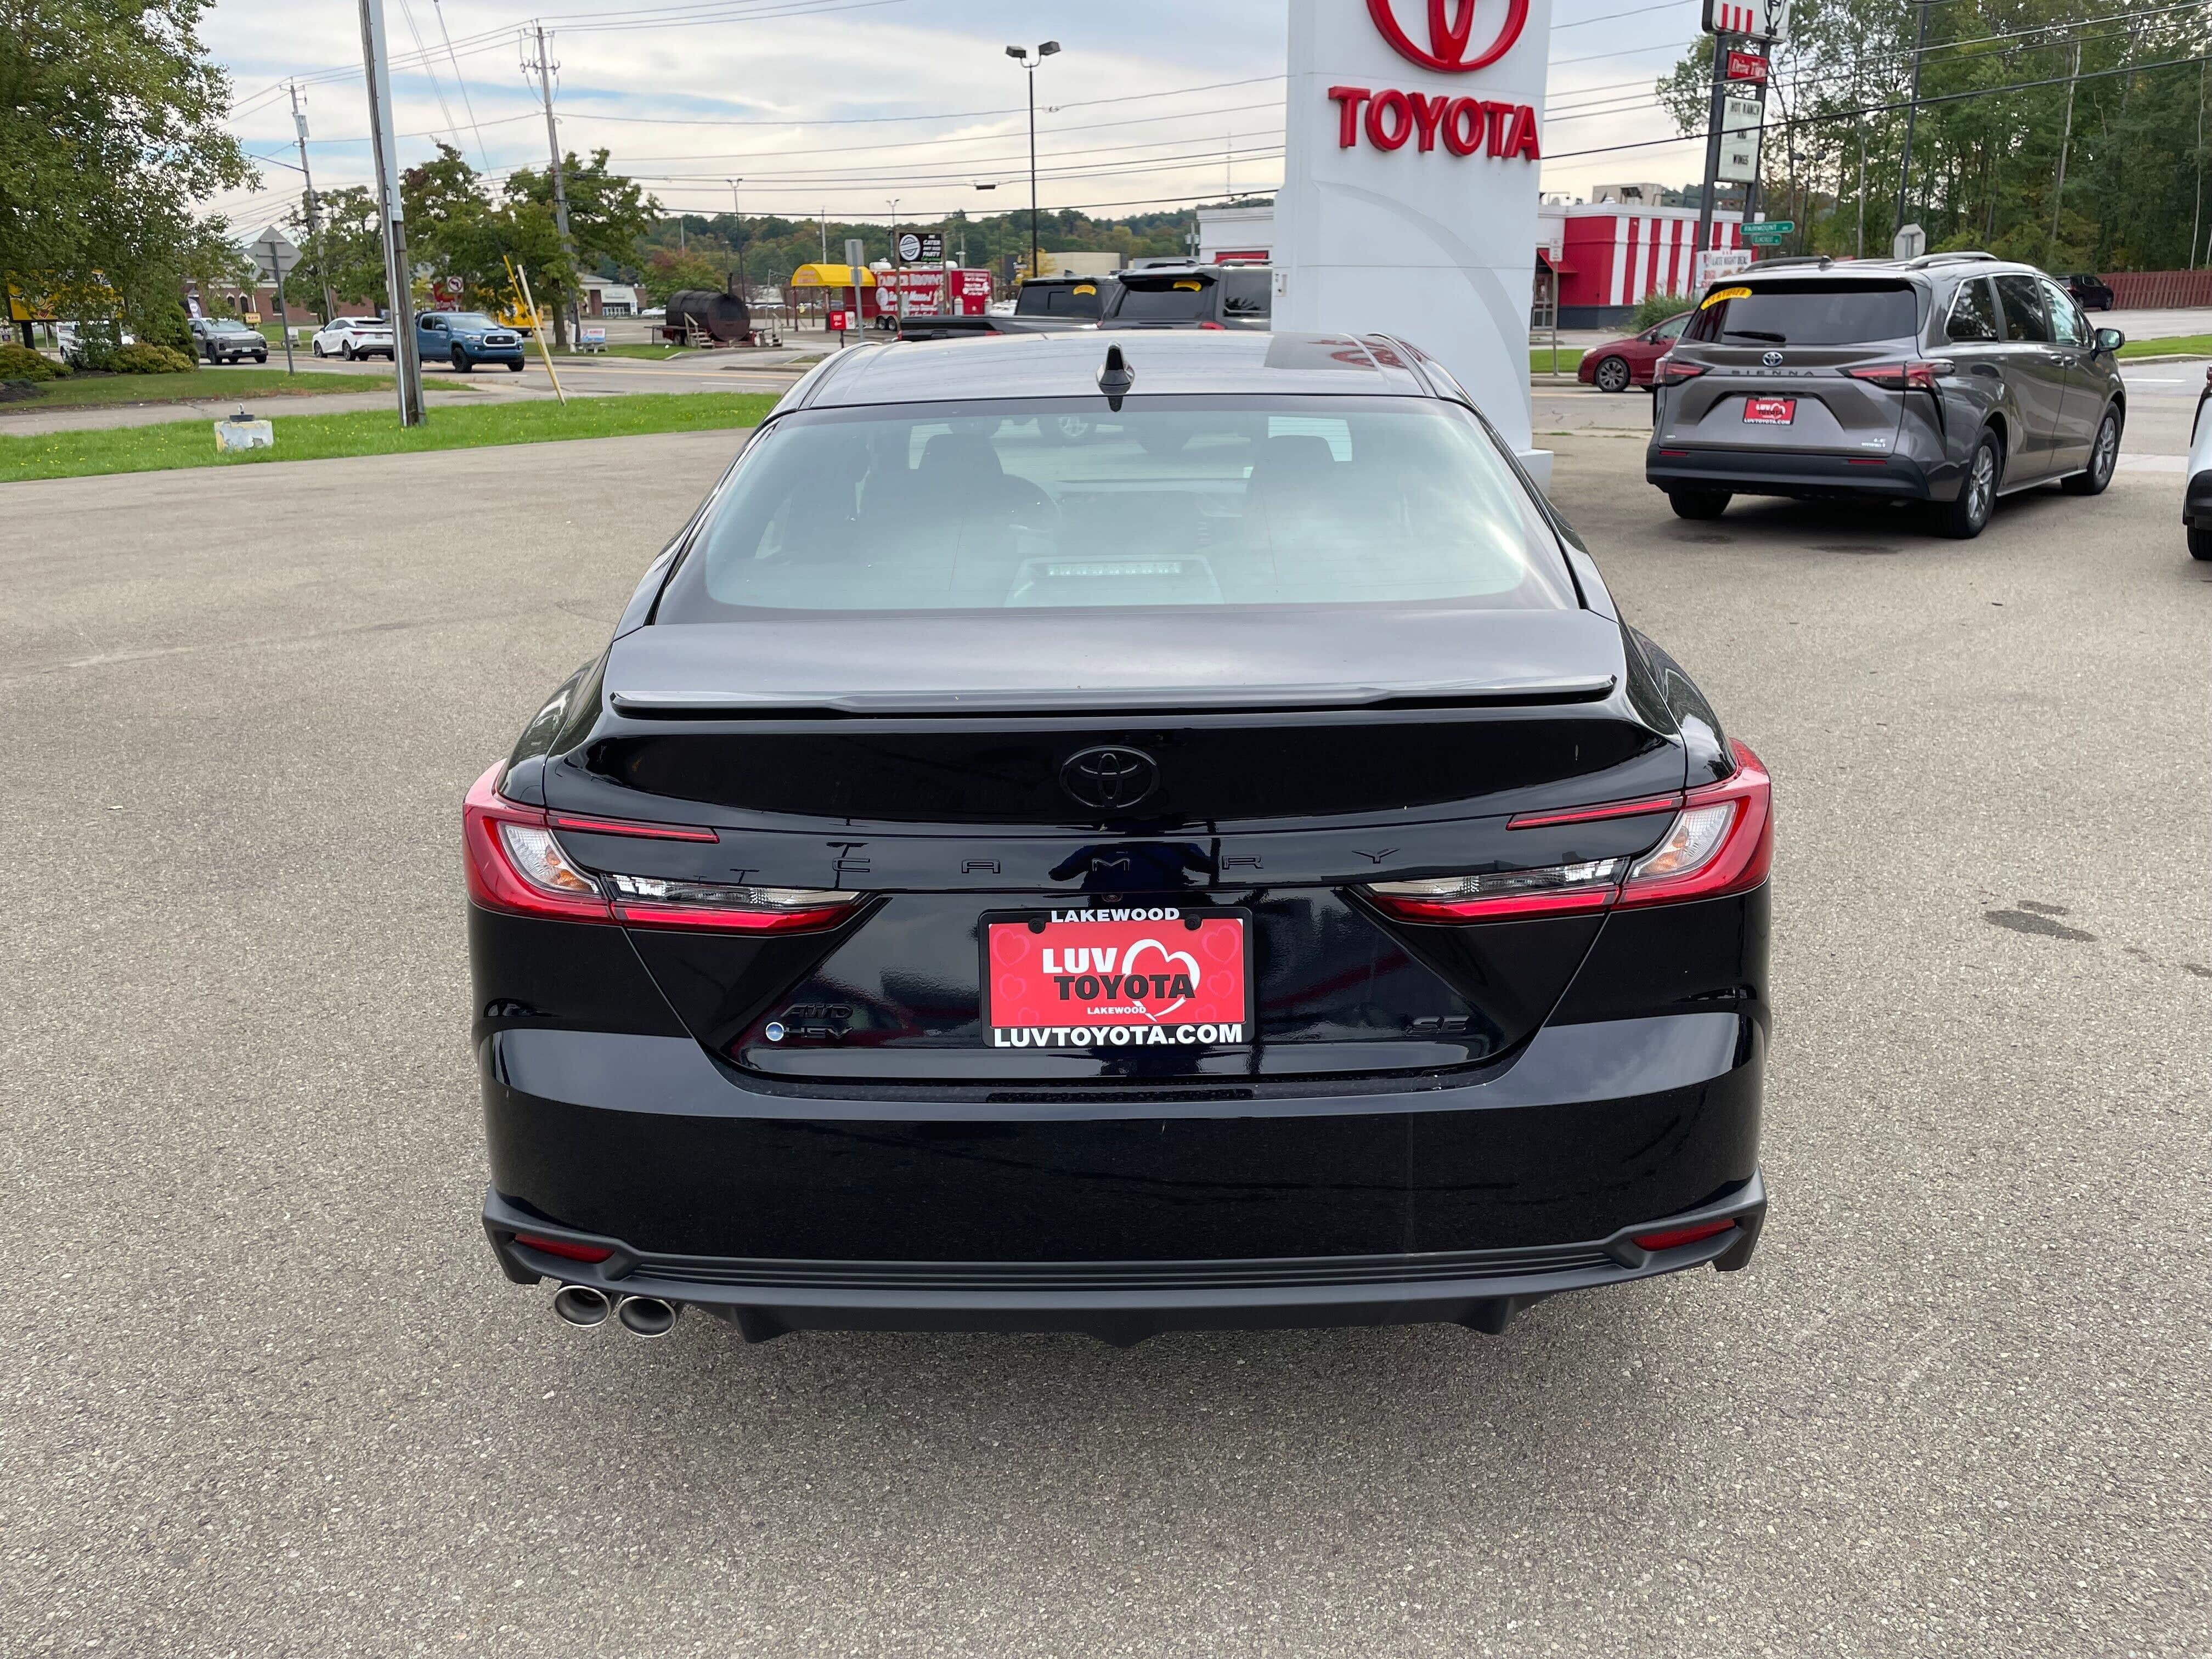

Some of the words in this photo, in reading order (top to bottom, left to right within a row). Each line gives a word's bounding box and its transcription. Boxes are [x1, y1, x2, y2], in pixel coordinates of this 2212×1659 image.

[1328, 86, 1541, 161] TOYOTA
[832, 847, 1401, 874] CAMRY
[1051, 907, 1180, 923] LAKEWOOD
[1042, 947, 1118, 973] LUV
[1053, 974, 1196, 1000] TOYOTA
[780, 1003, 854, 1019] AWD
[1087, 1006, 1147, 1015] LAKEWOOD
[994, 1024, 1242, 1047] LUVTOYOTA.COM
[1406, 1015, 1470, 1036] SE
